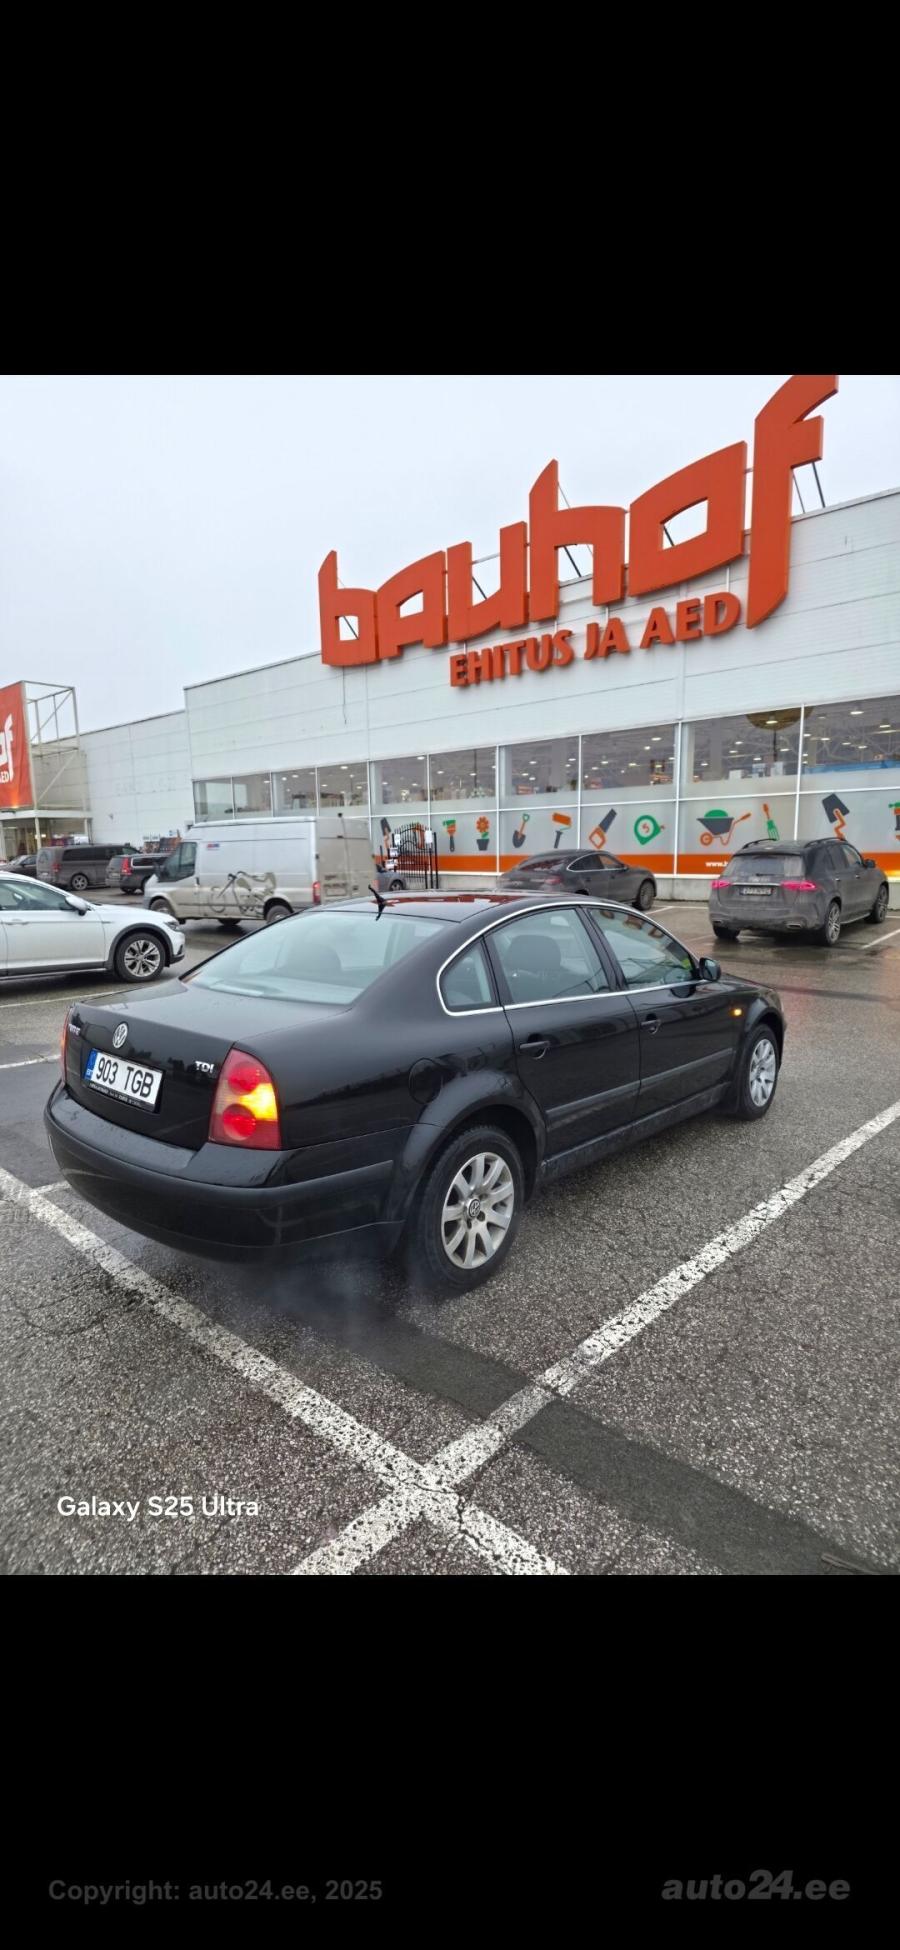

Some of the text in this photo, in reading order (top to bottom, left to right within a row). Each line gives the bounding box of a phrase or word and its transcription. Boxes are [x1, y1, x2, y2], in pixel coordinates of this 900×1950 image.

[450, 592, 742, 687] EHITUS JA AED
[96, 1057, 119, 1085] 903
[124, 1066, 154, 1098] TGB
[195, 1060, 215, 1074] TDI
